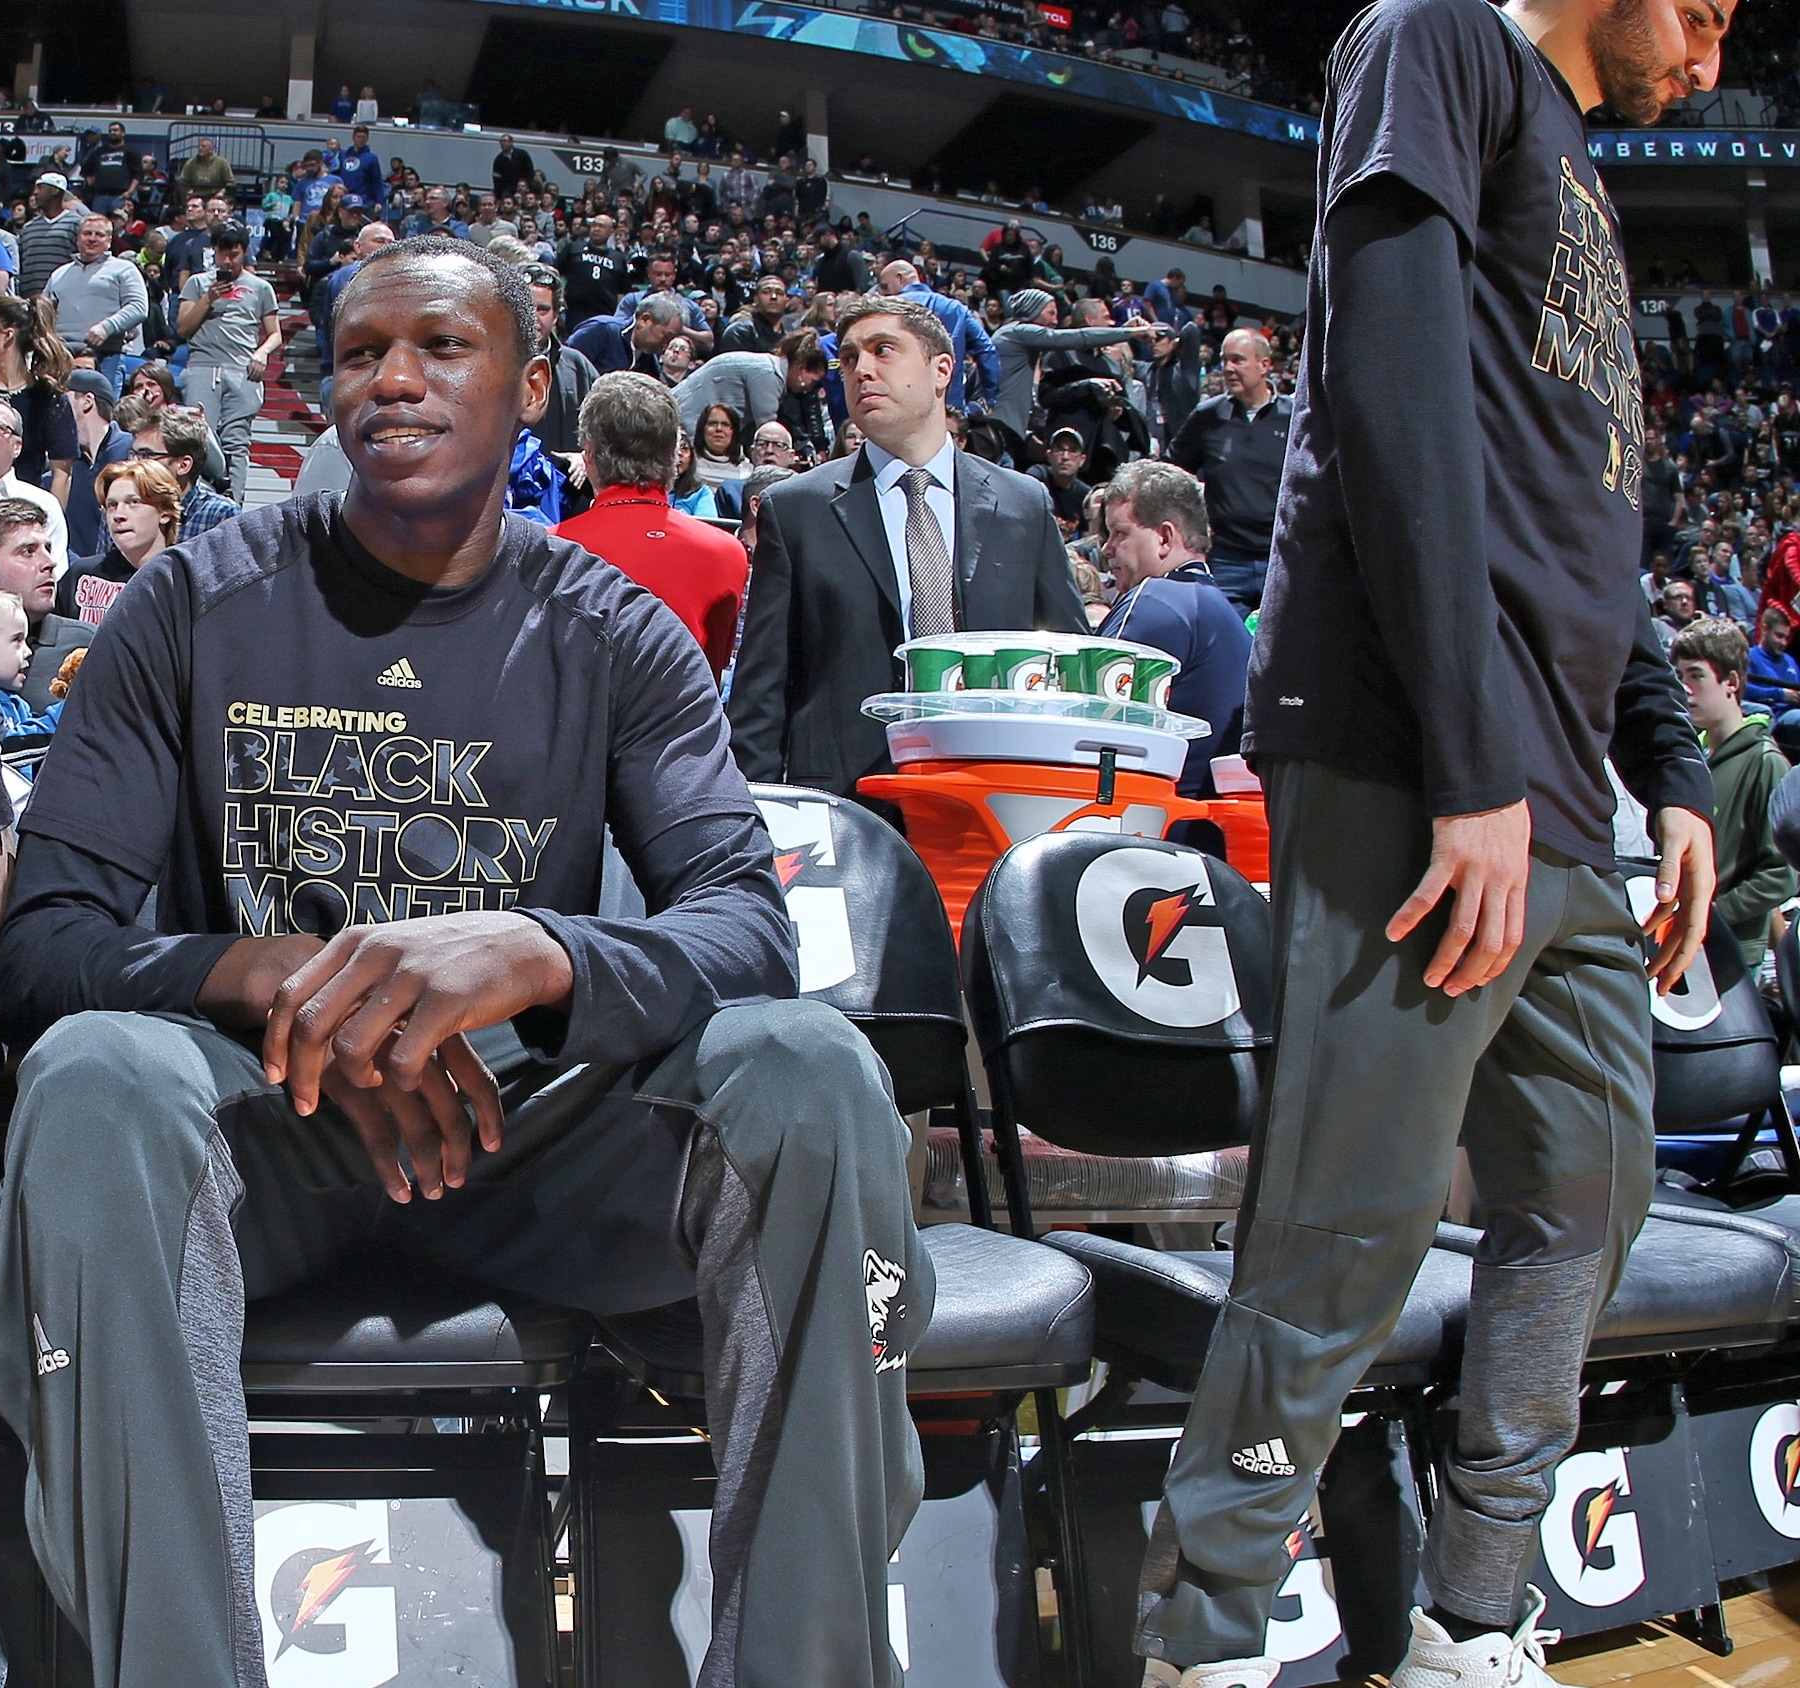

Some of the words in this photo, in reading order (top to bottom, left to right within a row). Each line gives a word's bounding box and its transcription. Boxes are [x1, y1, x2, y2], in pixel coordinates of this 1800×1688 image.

[1044, 11, 1068, 24] TCL
[1588, 142, 1796, 158] MBERWOLV
[573, 155, 604, 172] 133
[1090, 233, 1117, 251] 136
[581, 253, 615, 270] WOLVES
[591, 265, 601, 280] 8
[377, 674, 423, 689] adidas
[227, 701, 407, 733] CELEBRATING
[223, 727, 493, 808] BLACK
[223, 802, 558, 884] HISTORY
[1075, 847, 1243, 1029] G
[1231, 1452, 1297, 1477] adidas
[1538, 1446, 1647, 1608] G
